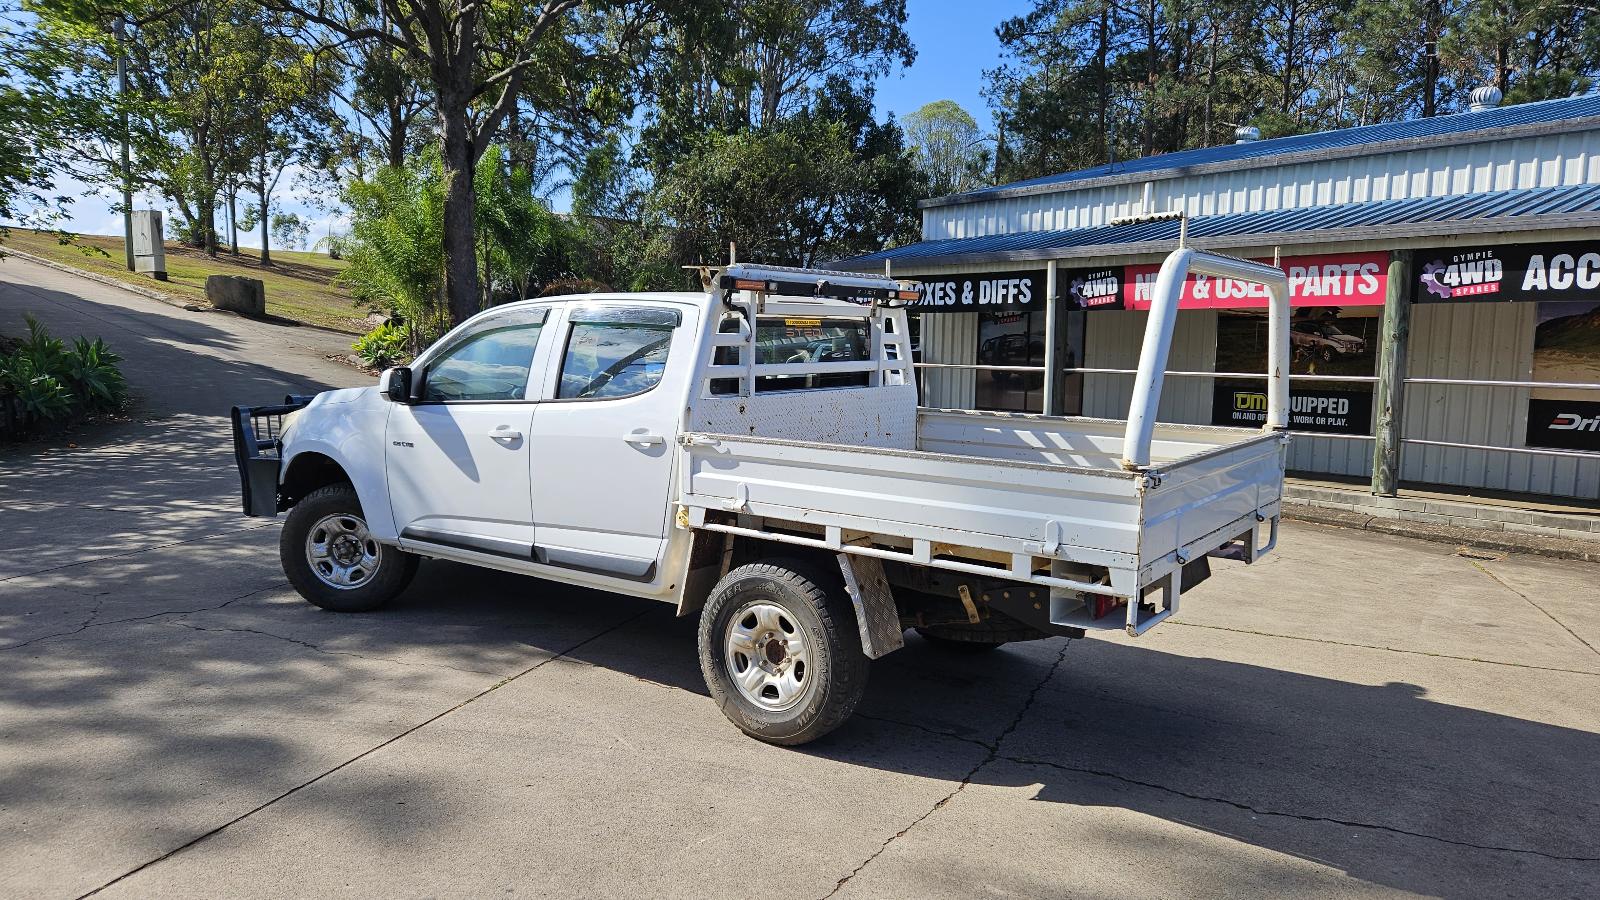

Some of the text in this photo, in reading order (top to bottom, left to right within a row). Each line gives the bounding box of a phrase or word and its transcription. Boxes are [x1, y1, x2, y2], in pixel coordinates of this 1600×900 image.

[1453, 250, 1493, 263] GYMPIE
[1088, 270, 1112, 280] GYMPIE
[1443, 258, 1503, 287] 4WD
[1289, 262, 1380, 297] PARTS
[961, 280, 974, 305] &
[978, 278, 1032, 305] DIFFS
[1082, 276, 1119, 298] 4WD
[1456, 284, 1497, 296] SPARES
[1090, 295, 1116, 305] SPARES
[1288, 396, 1349, 415] UIPPED
[1232, 411, 1242, 420] ON
[1242, 412, 1257, 421] AND
[1293, 415, 1348, 427] WORK OR PLAY.
